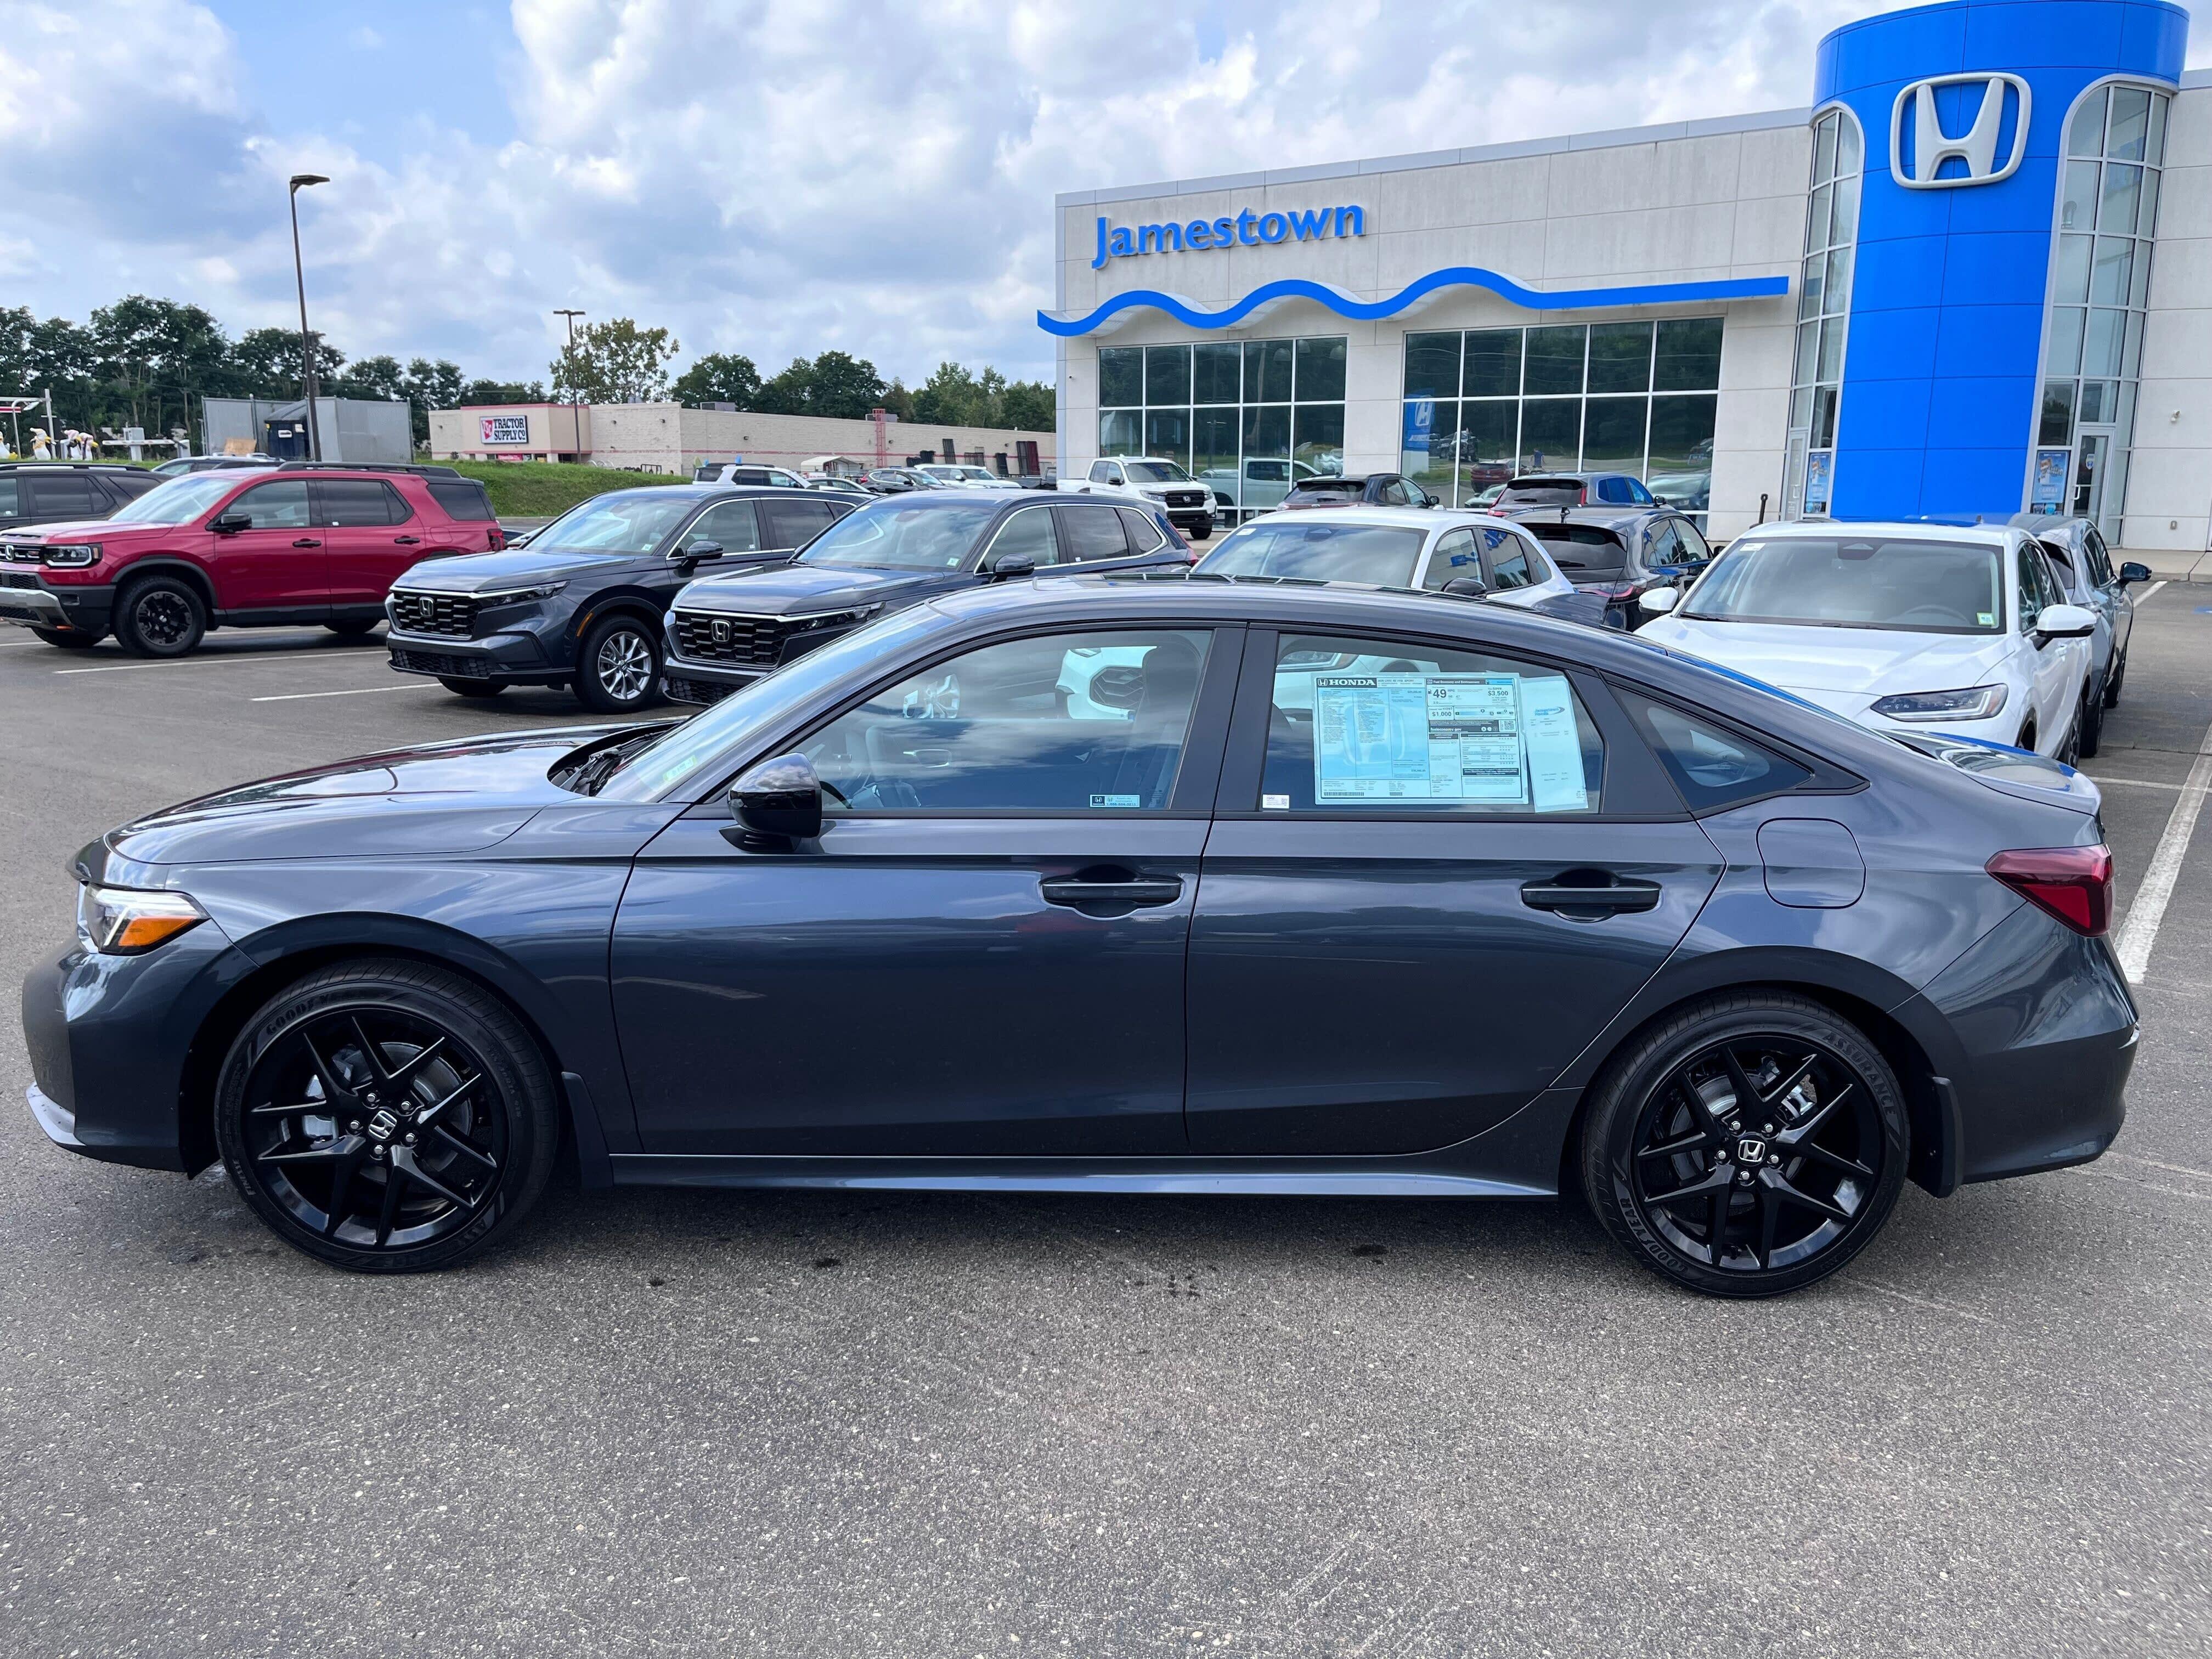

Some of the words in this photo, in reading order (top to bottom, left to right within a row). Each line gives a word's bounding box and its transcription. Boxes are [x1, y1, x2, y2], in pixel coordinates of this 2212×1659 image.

[1091, 204, 1368, 269] Jamestown
[494, 418, 524, 429] TRACTOR
[494, 430, 517, 441] SUPPLY
[1433, 689, 1447, 698] 49
[1822, 1032, 1897, 1115] ASSURANCE
[1620, 1198, 1688, 1273] GOODYEAR
